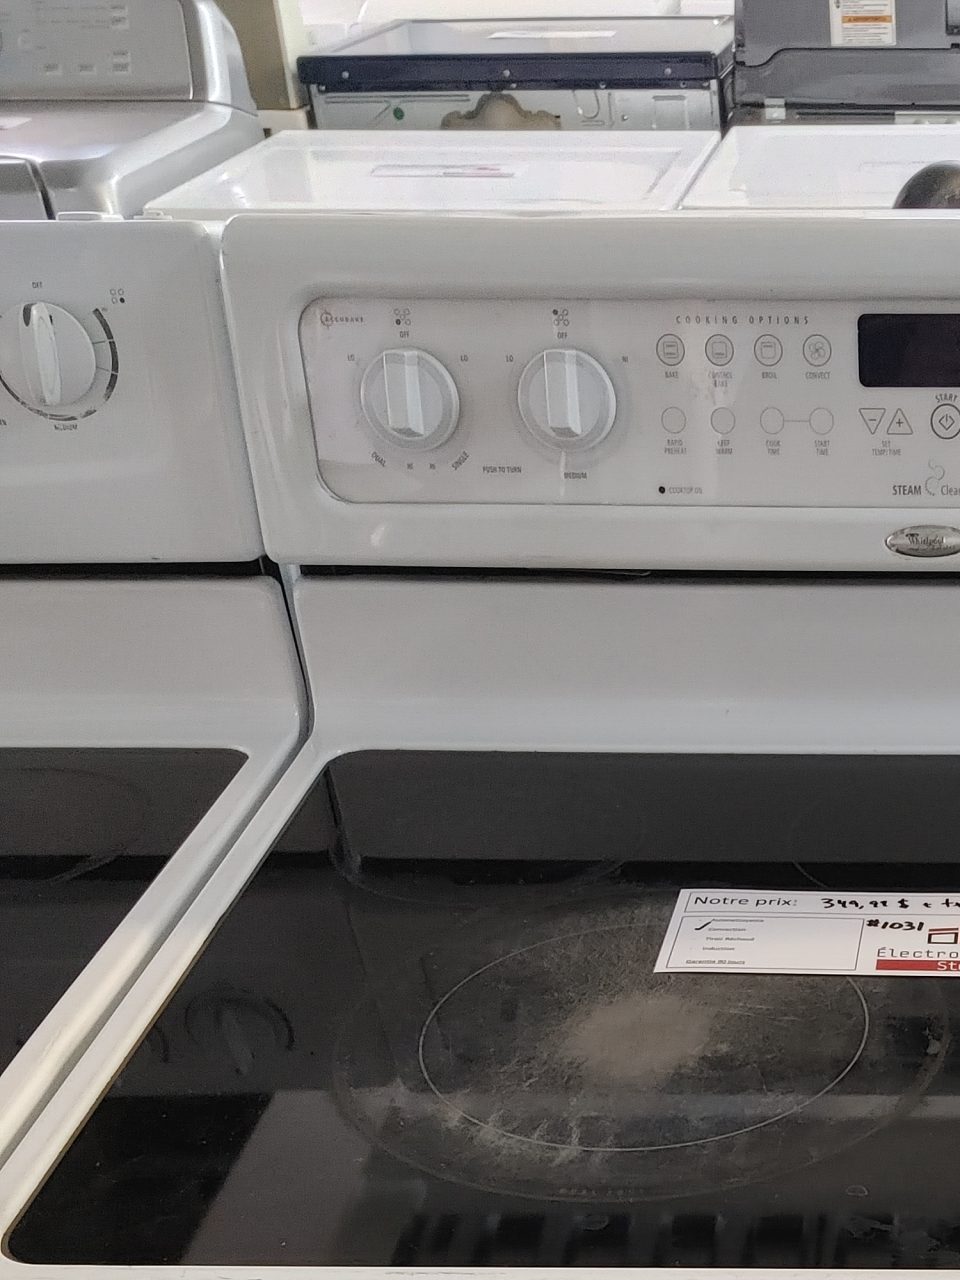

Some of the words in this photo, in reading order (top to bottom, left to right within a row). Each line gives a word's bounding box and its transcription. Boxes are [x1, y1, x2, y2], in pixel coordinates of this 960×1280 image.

[676, 315, 738, 325] COOKING
[748, 315, 809, 325] OPTIONS
[399, 330, 410, 339] OFF
[557, 331, 568, 340] OFF
[761, 371, 778, 379] BROIL
[805, 371, 831, 380] CONVECT
[935, 392, 958, 403] START
[370, 451, 387, 468] DUAL
[451, 450, 470, 471] SINGLE
[482, 465, 498, 474] PUSH
[498, 465, 506, 474] TO
[506, 465, 522, 474] TURN
[563, 471, 588, 480] MEDIUM
[892, 484, 922, 496] STEAM
[694, 896, 749, 906] Notre
[755, 896, 798, 908] prix:
[866, 919, 925, 931] #1031
